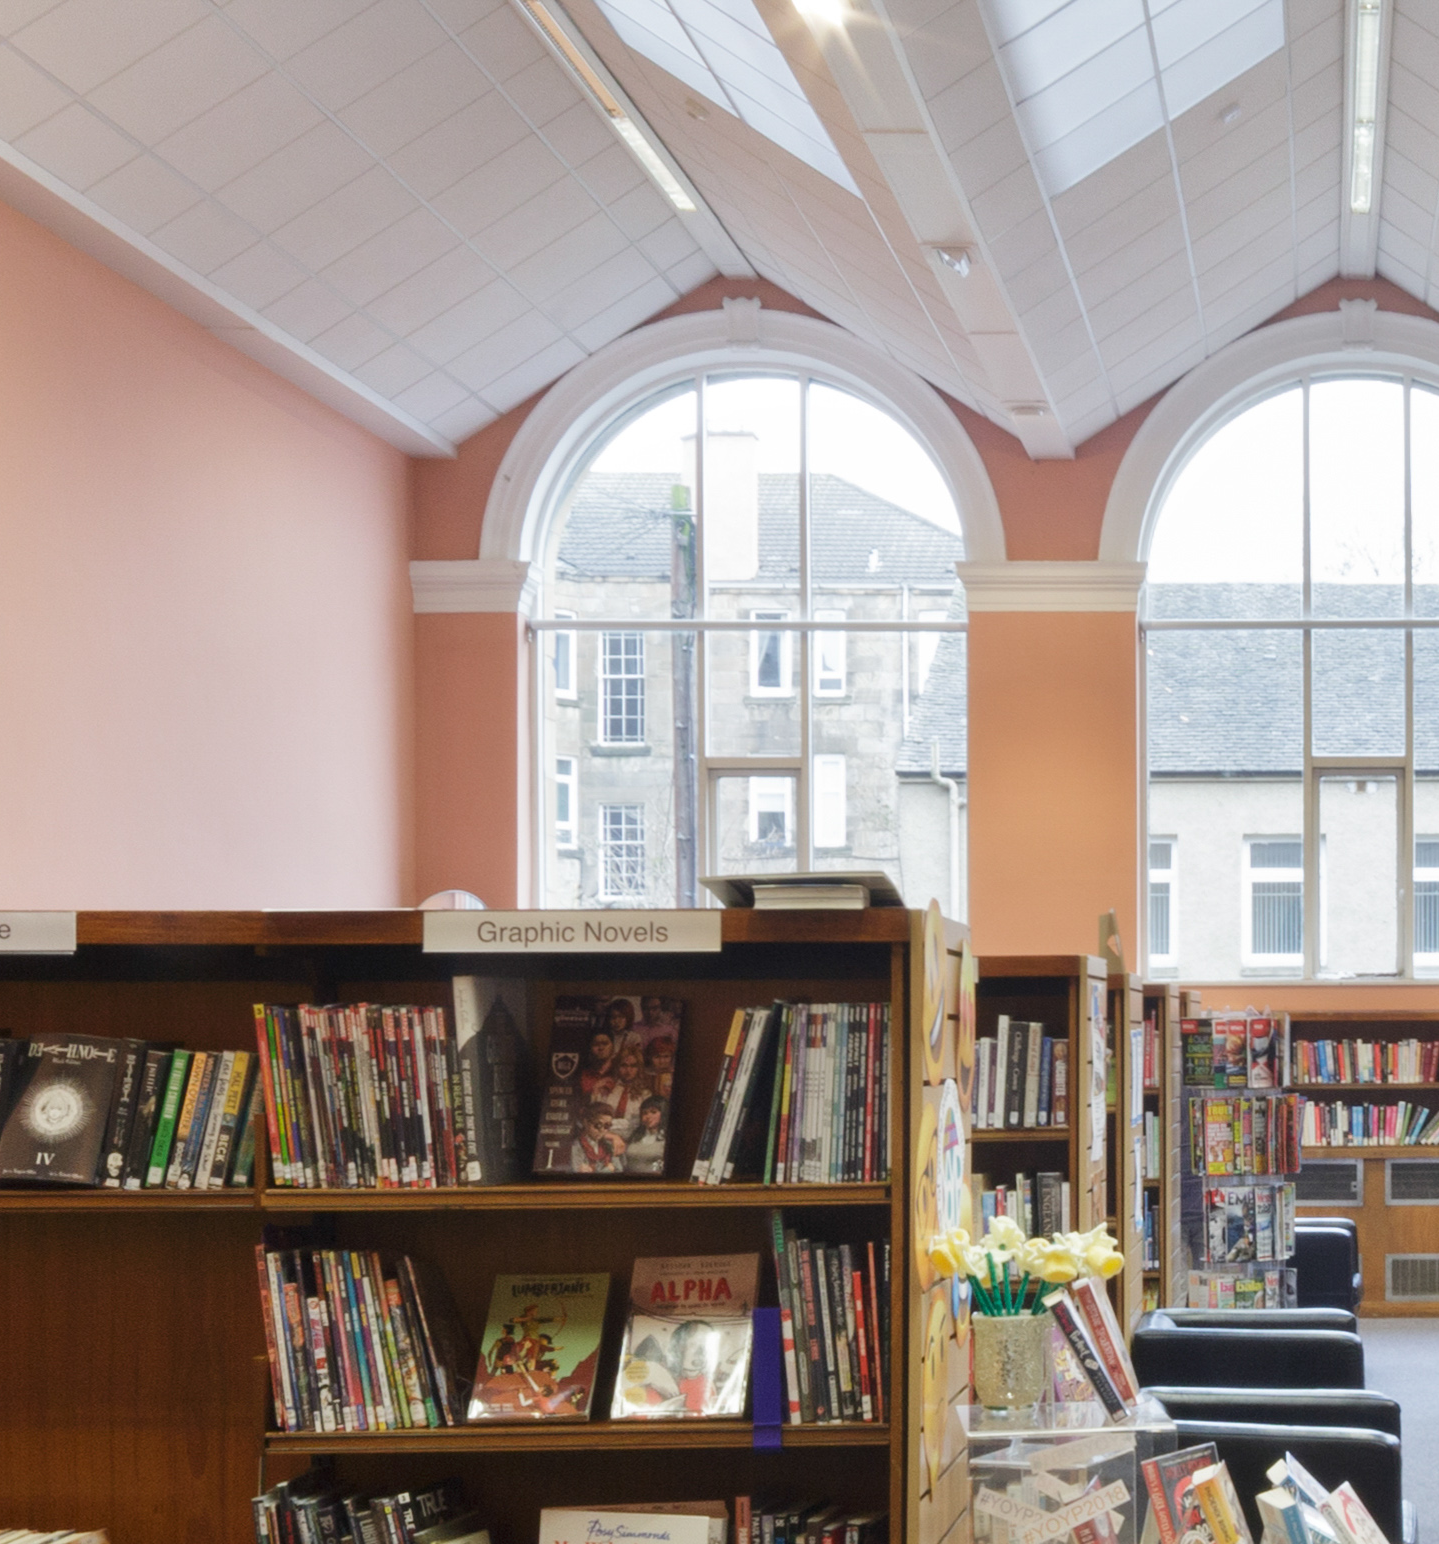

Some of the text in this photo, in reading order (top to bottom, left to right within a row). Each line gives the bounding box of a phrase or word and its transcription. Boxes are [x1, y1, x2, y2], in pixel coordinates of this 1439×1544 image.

[477, 920, 669, 948] Graphic Novels
[35, 1151, 57, 1167] IV
[214, 1134, 230, 1164] BECK
[511, 1280, 592, 1298] LUMBERJANES
[649, 1276, 733, 1305] ALPHA
[586, 1518, 672, 1543] Posy Simmonds
